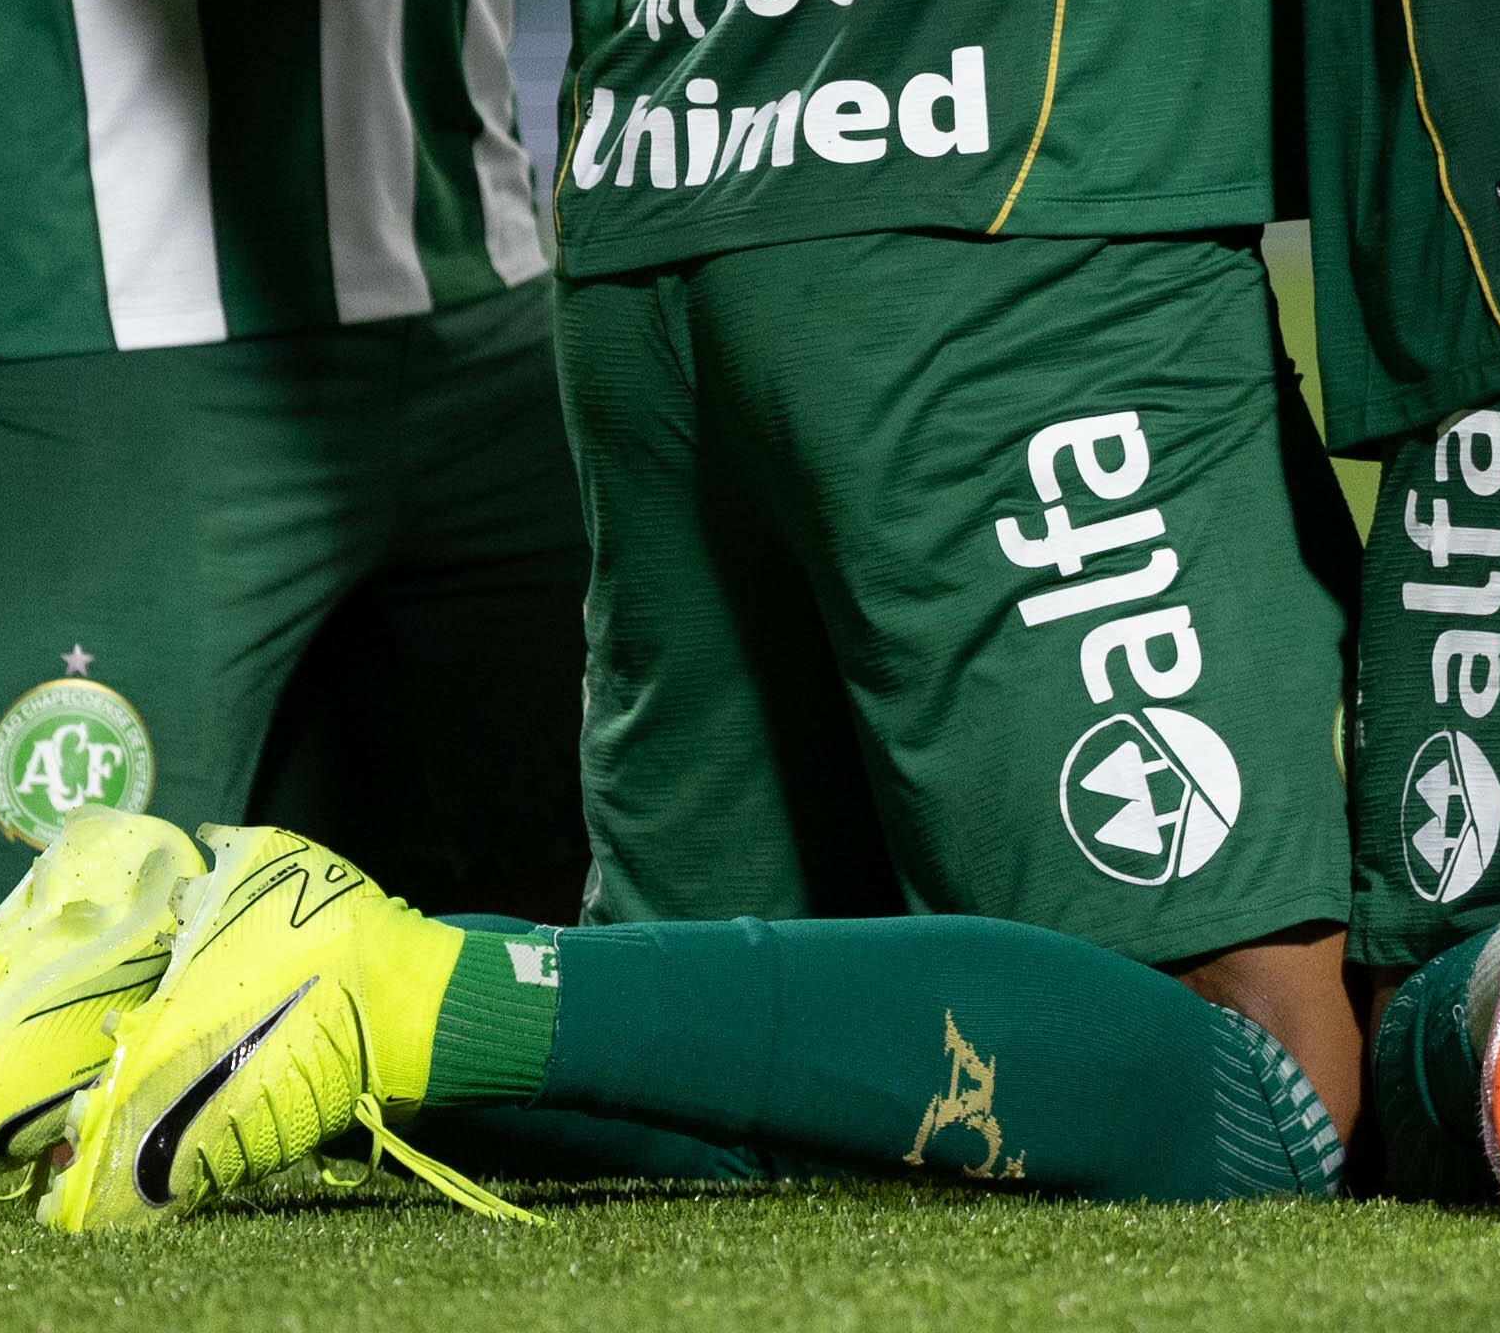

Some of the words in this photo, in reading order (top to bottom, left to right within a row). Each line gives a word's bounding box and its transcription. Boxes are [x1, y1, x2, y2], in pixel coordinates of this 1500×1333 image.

[572, 44, 991, 191] Unimed
[994, 410, 1203, 706] alfa
[16, 720, 123, 813] ACF
